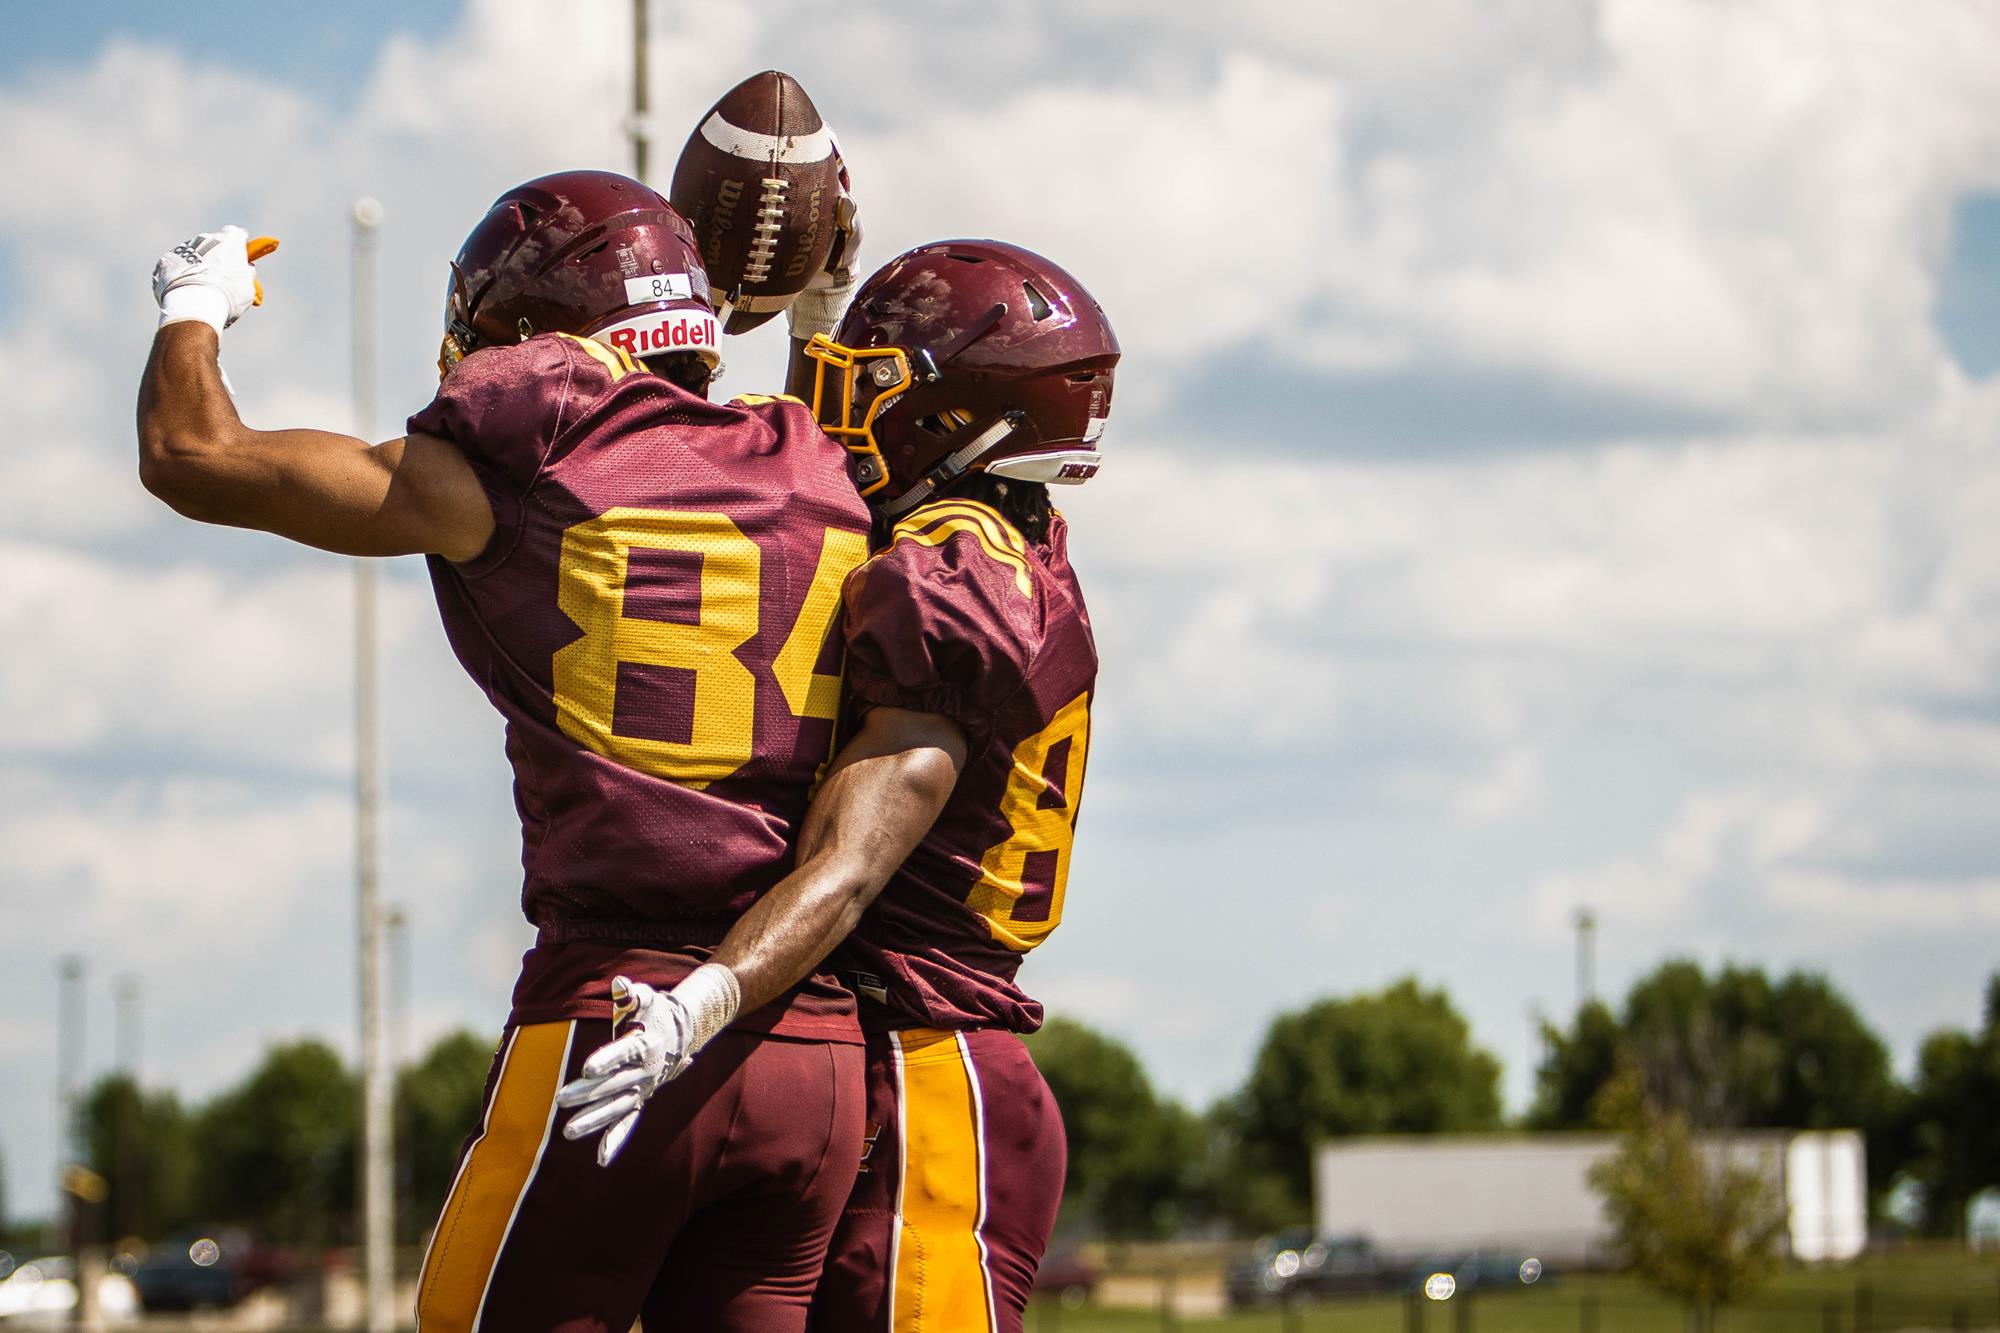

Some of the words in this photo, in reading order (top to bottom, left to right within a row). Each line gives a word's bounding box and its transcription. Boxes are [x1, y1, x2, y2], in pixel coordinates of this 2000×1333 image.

[708, 179, 744, 266] Wilson
[785, 189, 821, 278] Wilson
[651, 278, 673, 298] 84
[609, 318, 715, 354] Riddell
[965, 691, 1091, 953] 8
